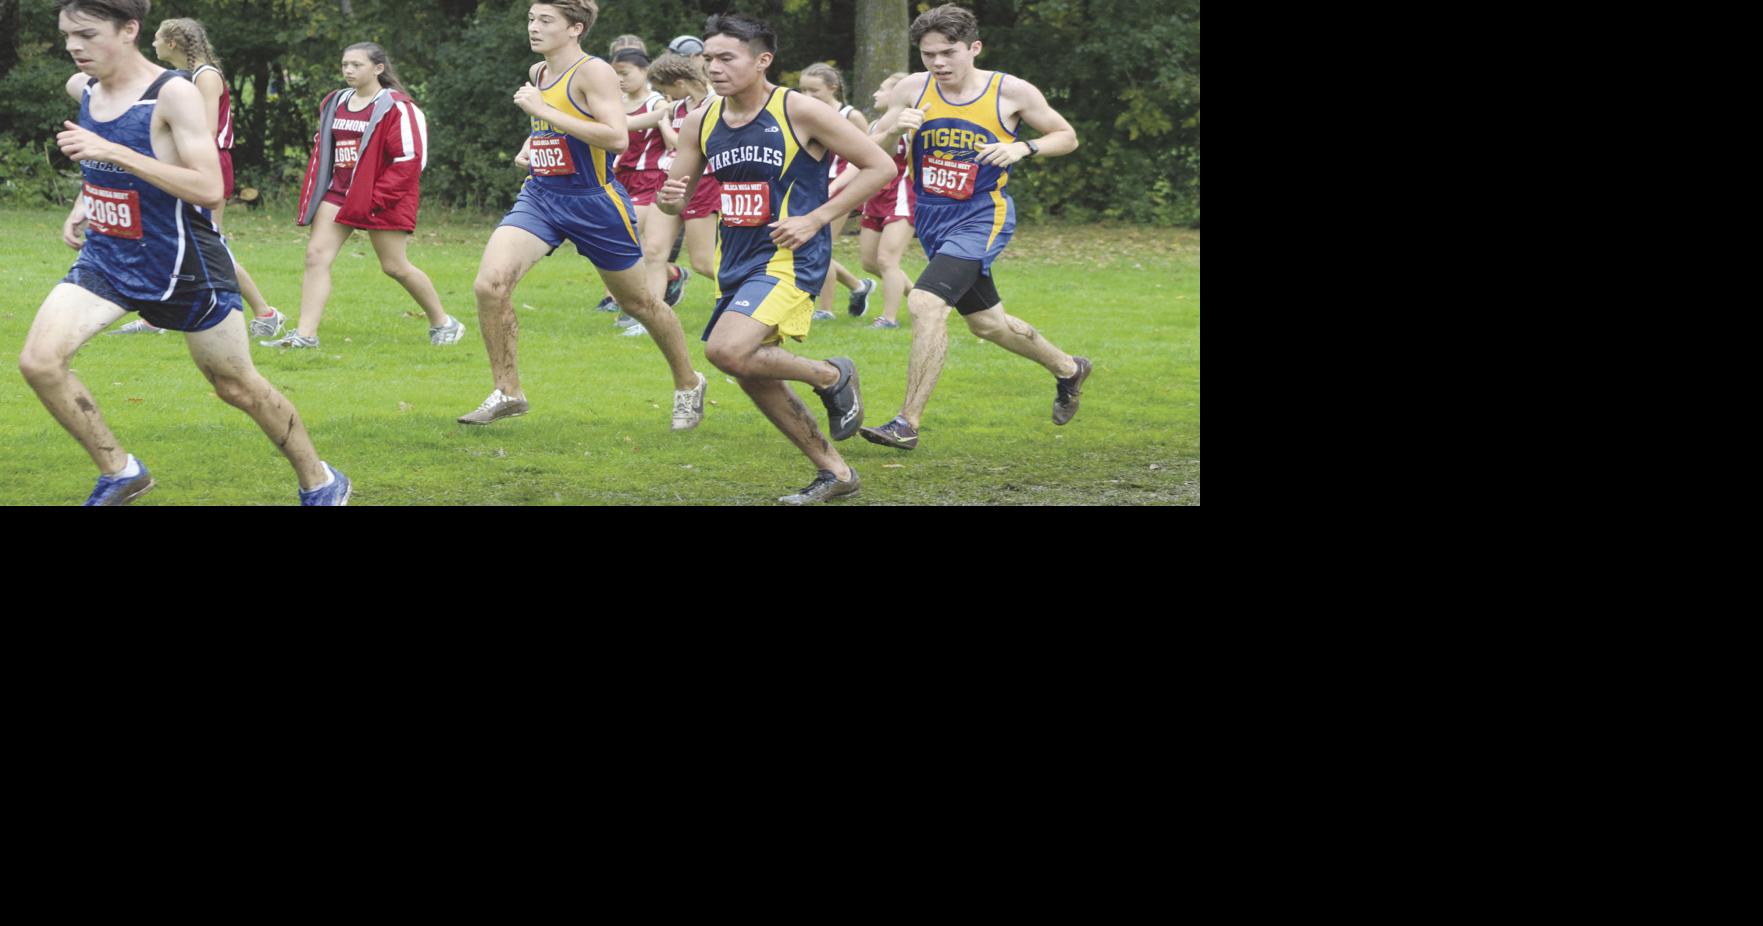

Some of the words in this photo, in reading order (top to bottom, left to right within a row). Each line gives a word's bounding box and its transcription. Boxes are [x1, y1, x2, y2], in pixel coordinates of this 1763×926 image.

[921, 128, 987, 153] TIGERS
[335, 146, 358, 162] 1605
[531, 148, 565, 168] 5062
[84, 195, 132, 227] 2069
[724, 193, 763, 216] 1012
